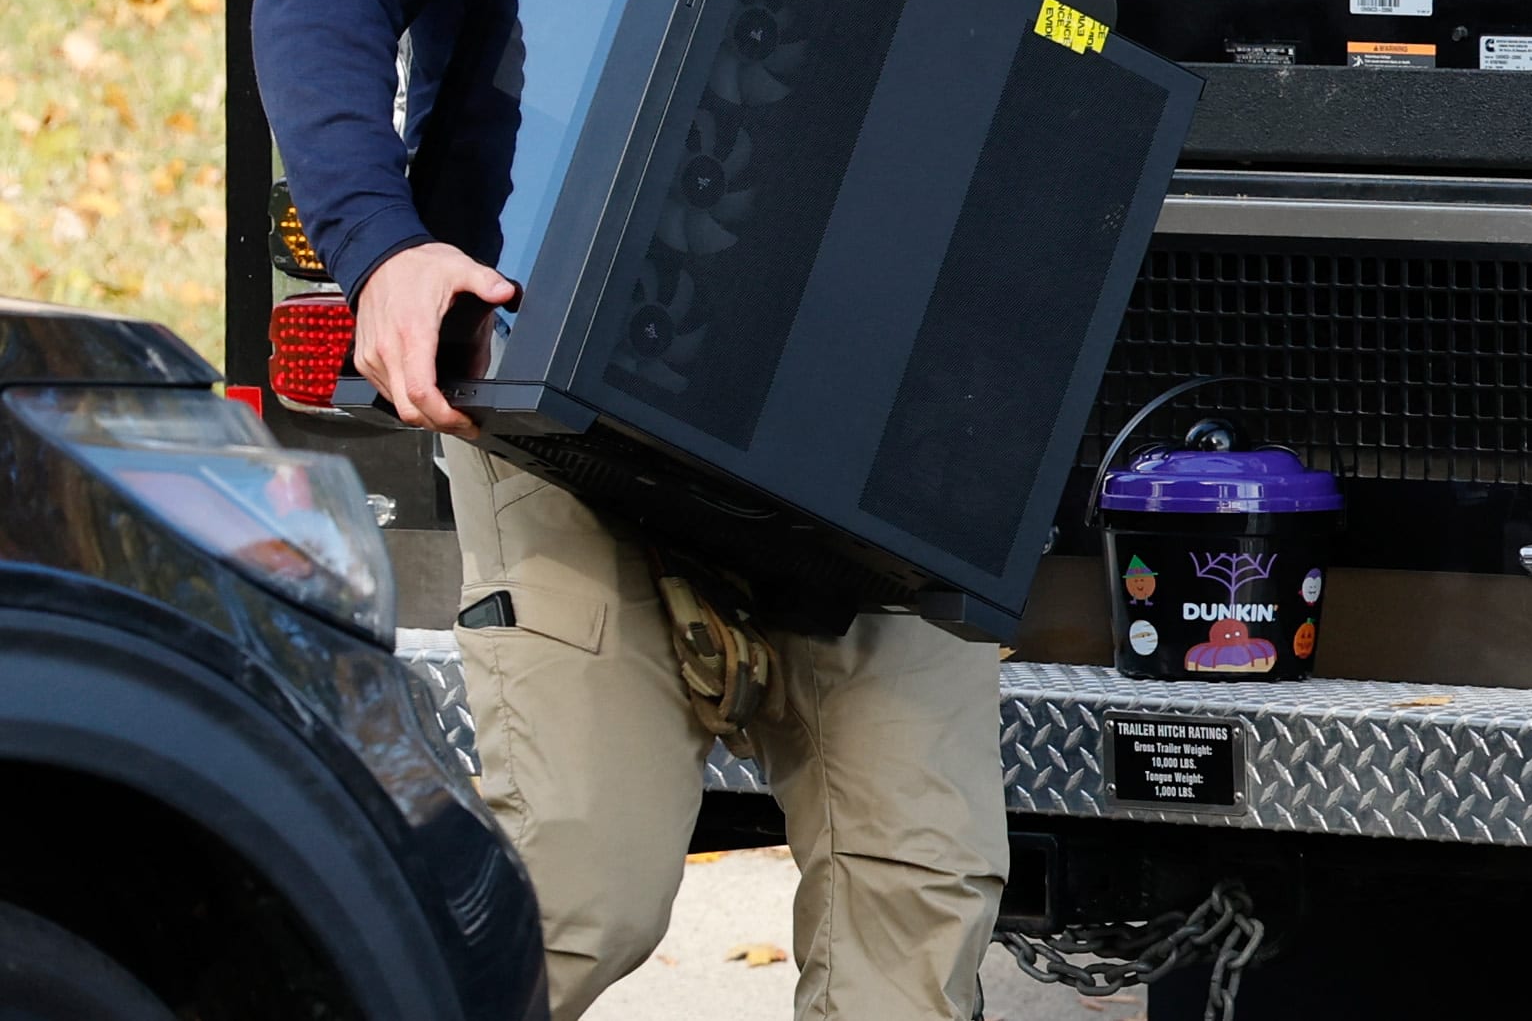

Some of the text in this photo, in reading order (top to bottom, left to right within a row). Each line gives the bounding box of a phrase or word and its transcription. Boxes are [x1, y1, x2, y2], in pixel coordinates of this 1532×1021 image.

[1379, 45, 1409, 53] WARNING
[1182, 602, 1279, 623] DUNKIN'
[1117, 722, 1228, 741] TRAILER HITCH RATINGS
[1133, 741, 1213, 757] Gross Trailer Weight:
[1151, 756, 1197, 770] 10,000 LBS.
[1144, 770, 1204, 786] Tongue Weight:
[1154, 785, 1196, 799] 1,000 LBS.
